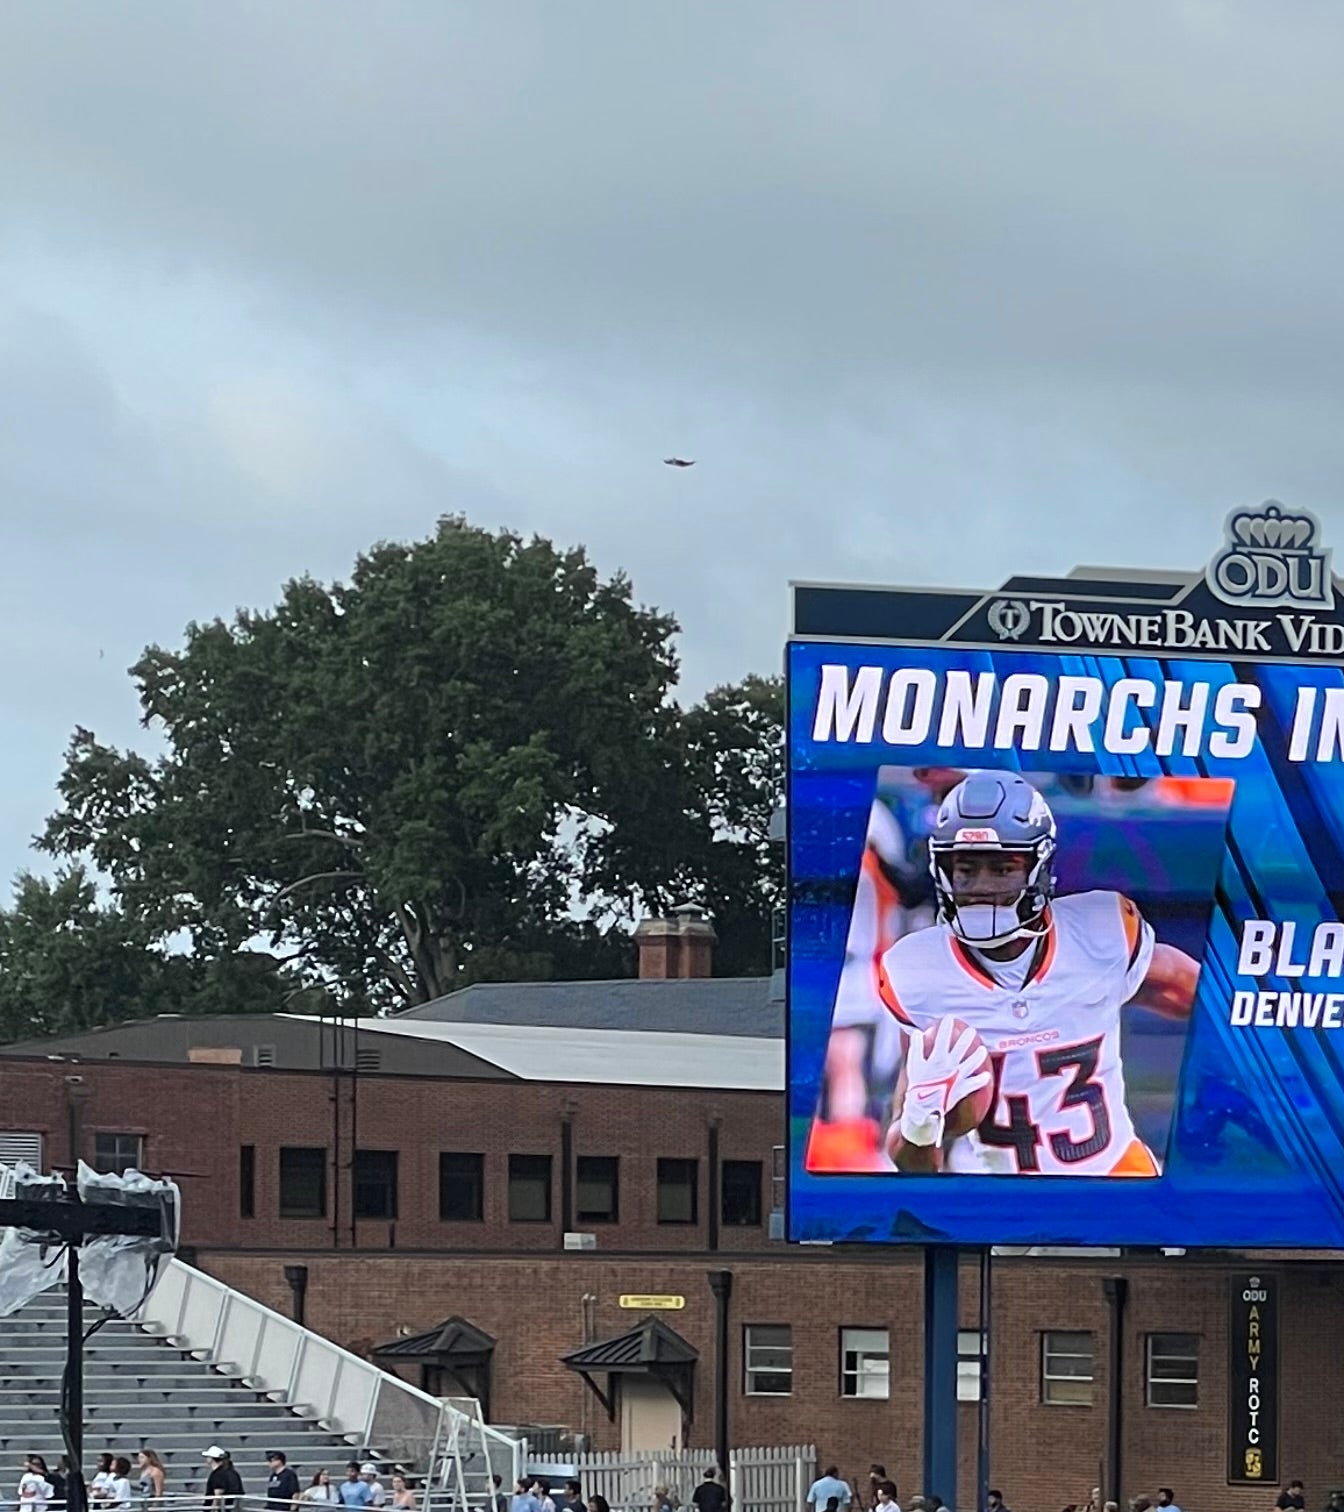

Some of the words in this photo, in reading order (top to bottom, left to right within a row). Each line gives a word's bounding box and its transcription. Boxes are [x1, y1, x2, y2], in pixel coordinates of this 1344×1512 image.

[1215, 550, 1325, 601] ODU
[812, 664, 1260, 759] MONARCHS
[976, 1033, 1111, 1172] 43
[1243, 1290, 1267, 1301] ODU
[1248, 1378, 1260, 1444] ROTC
